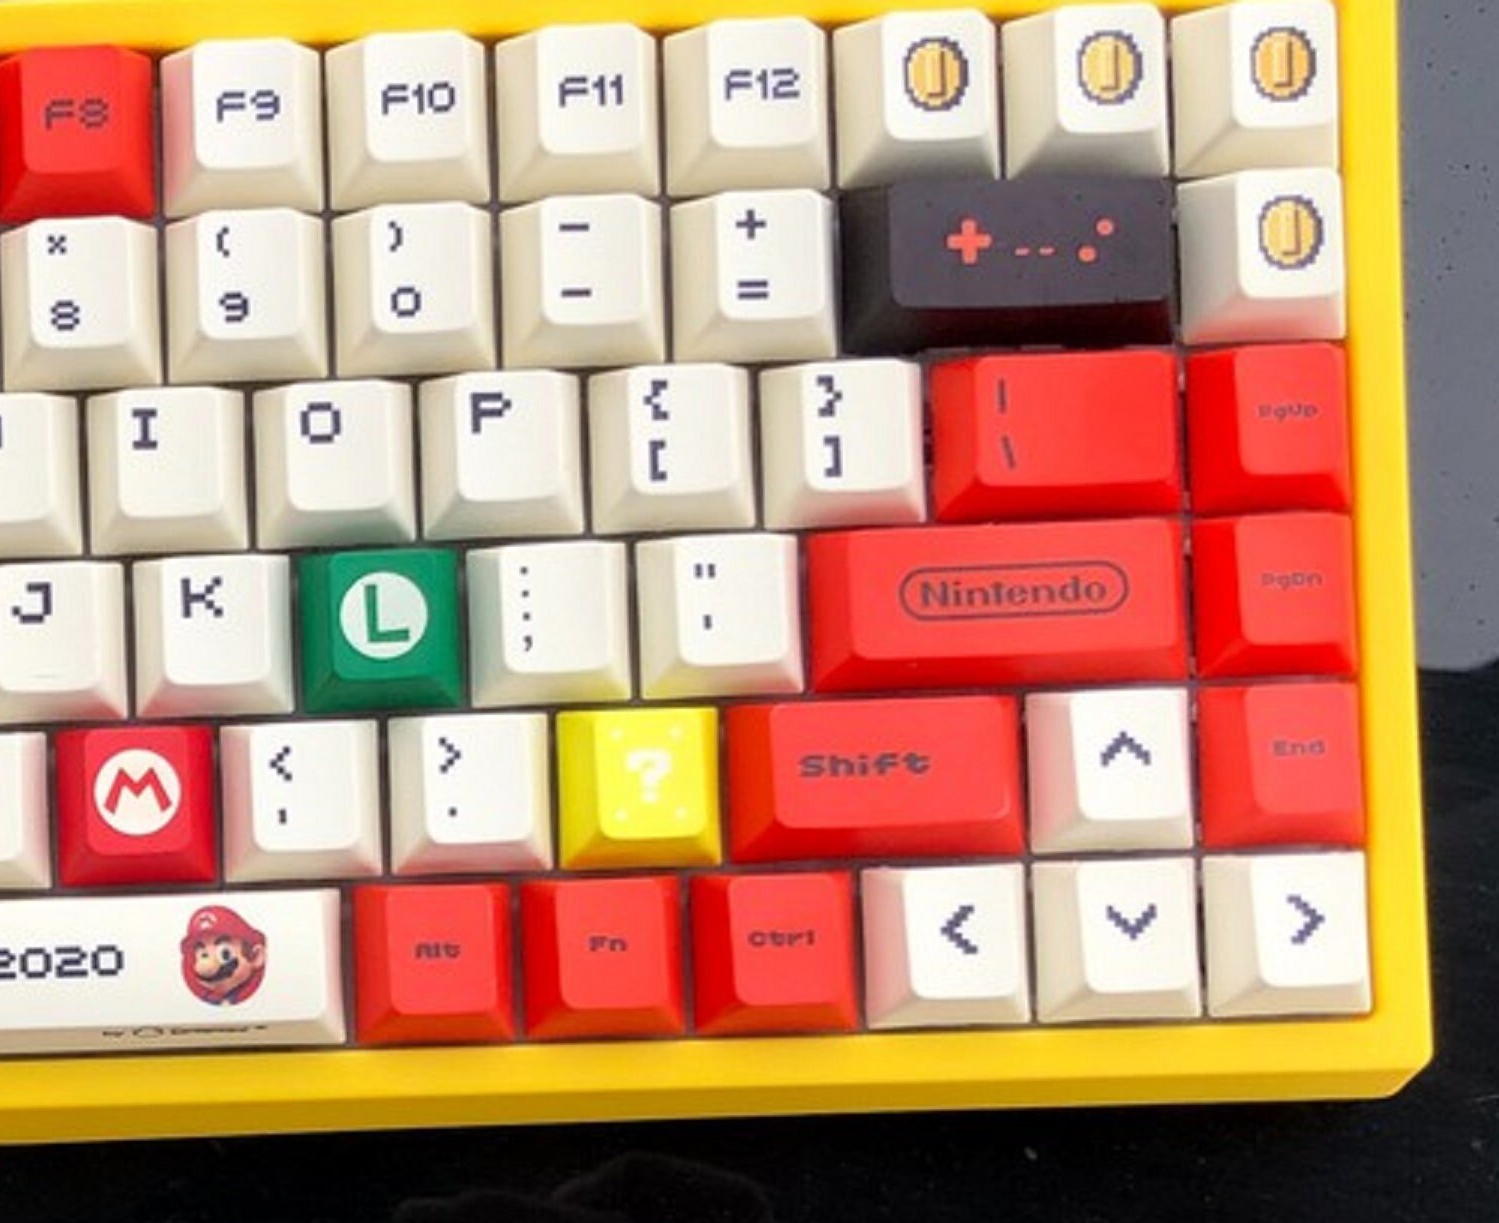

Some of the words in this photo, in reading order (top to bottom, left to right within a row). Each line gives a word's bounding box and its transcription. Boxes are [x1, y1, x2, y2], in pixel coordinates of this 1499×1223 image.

[382, 82, 455, 114] F10
[559, 75, 623, 107] F11
[725, 68, 800, 100] F12
[41, 98, 108, 129] F8
[217, 90, 280, 122] F9
[389, 221, 402, 252] )
[736, 210, 766, 239] +
[217, 227, 230, 257] (
[391, 287, 421, 317] 0
[738, 280, 768, 299] =
[51, 301, 80, 331] 8
[219, 292, 248, 322] 9
[471, 392, 511, 433] P
[644, 380, 668, 420] {
[817, 376, 842, 417] }
[132, 409, 158, 450] I
[301, 402, 341, 443] O
[649, 440, 667, 481] [
[824, 436, 842, 477] ]
[12, 582, 51, 624] J
[181, 577, 223, 618] K
[919, 575, 1108, 609] Nintendo
[364, 584, 410, 643] L
[1270, 738, 1325, 758] End
[626, 748, 672, 803] ?
[800, 752, 930, 777] Shift
[103, 766, 172, 813] M
[416, 943, 460, 958] Alt
[590, 936, 627, 952] Fn
[748, 930, 814, 947] Ctrl
